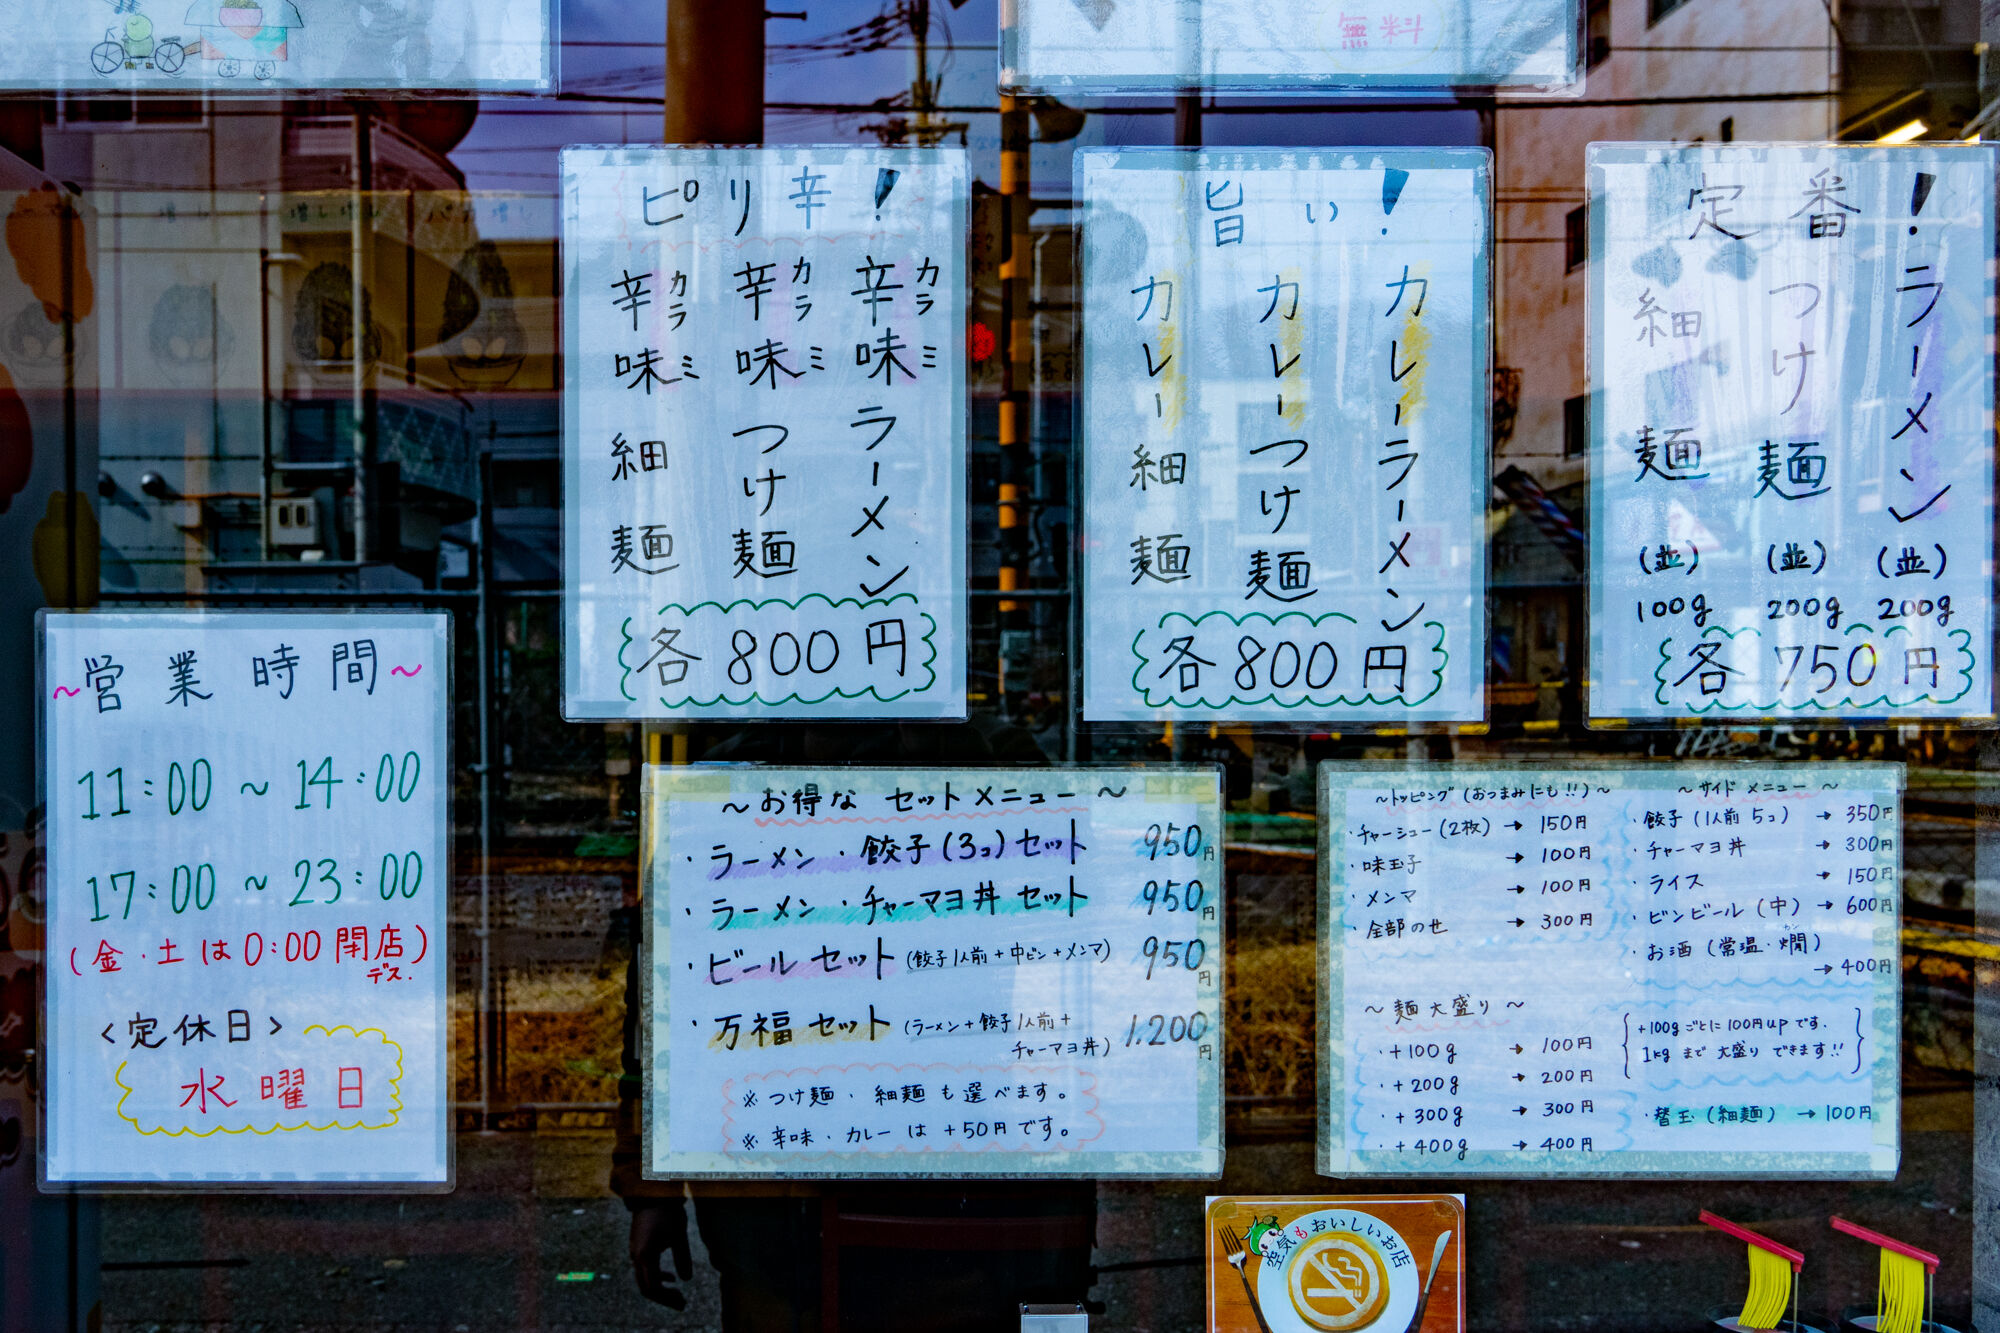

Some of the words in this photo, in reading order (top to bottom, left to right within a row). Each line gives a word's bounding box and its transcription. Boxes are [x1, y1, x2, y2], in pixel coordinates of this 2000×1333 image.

[1338, 12, 1424, 49] 無料
[644, 165, 900, 235] ピリ辛!
[1206, 168, 1409, 246] 旨い!
[1687, 168, 1936, 241] 定番!
[1632, 288, 1709, 483] 細麺
[1754, 282, 1831, 500] つけ麺
[1889, 265, 1951, 523] ラーメン
[611, 270, 681, 575] 辛味細麺
[733, 260, 807, 579] 辛味つけ麺
[851, 256, 917, 596] 辛味ラーメン
[1131, 275, 1191, 586] カレー細麺
[1246, 274, 1318, 601] カレーつけ麺
[1378, 265, 1428, 631] カレーラーメン
[1639, 540, 1698, 575] (並)
[1767, 540, 1826, 574] (並)
[1878, 544, 1947, 580] (並)
[1638, 594, 1712, 626] 100g
[1767, 596, 1843, 629] 200g
[1878, 595, 1953, 627] 200g
[637, 619, 905, 686] 各800円
[1159, 635, 1407, 692] 各800円
[1673, 641, 1939, 695] 各750円
[1541, 815, 1587, 833] 150円
[1846, 804, 1893, 824] 350円
[1363, 854, 1422, 875] 味玉子
[1542, 845, 1590, 863] 100円
[1647, 836, 1746, 860] チャーマヨ丼
[1845, 836, 1893, 852] 300円
[1366, 889, 1417, 907] メンマ
[1541, 878, 1590, 895] 100円
[1650, 873, 1704, 895] ライス
[1848, 866, 1893, 885] 150円
[1846, 895, 1893, 914] 600円
[1366, 918, 1448, 940] 全部のせ
[1541, 913, 1593, 930] 300円
[1841, 958, 1891, 975] 400円
[1542, 1036, 1592, 1054] 100円
[180, 1066, 363, 1113] 水曜日
[1541, 1070, 1593, 1084] 200円
[1542, 1100, 1594, 1117] 300円
[1826, 1105, 1872, 1121] 100円
[1540, 1137, 1592, 1152] 400円
[1266, 1216, 1410, 1270] 空気もおいしいお店
